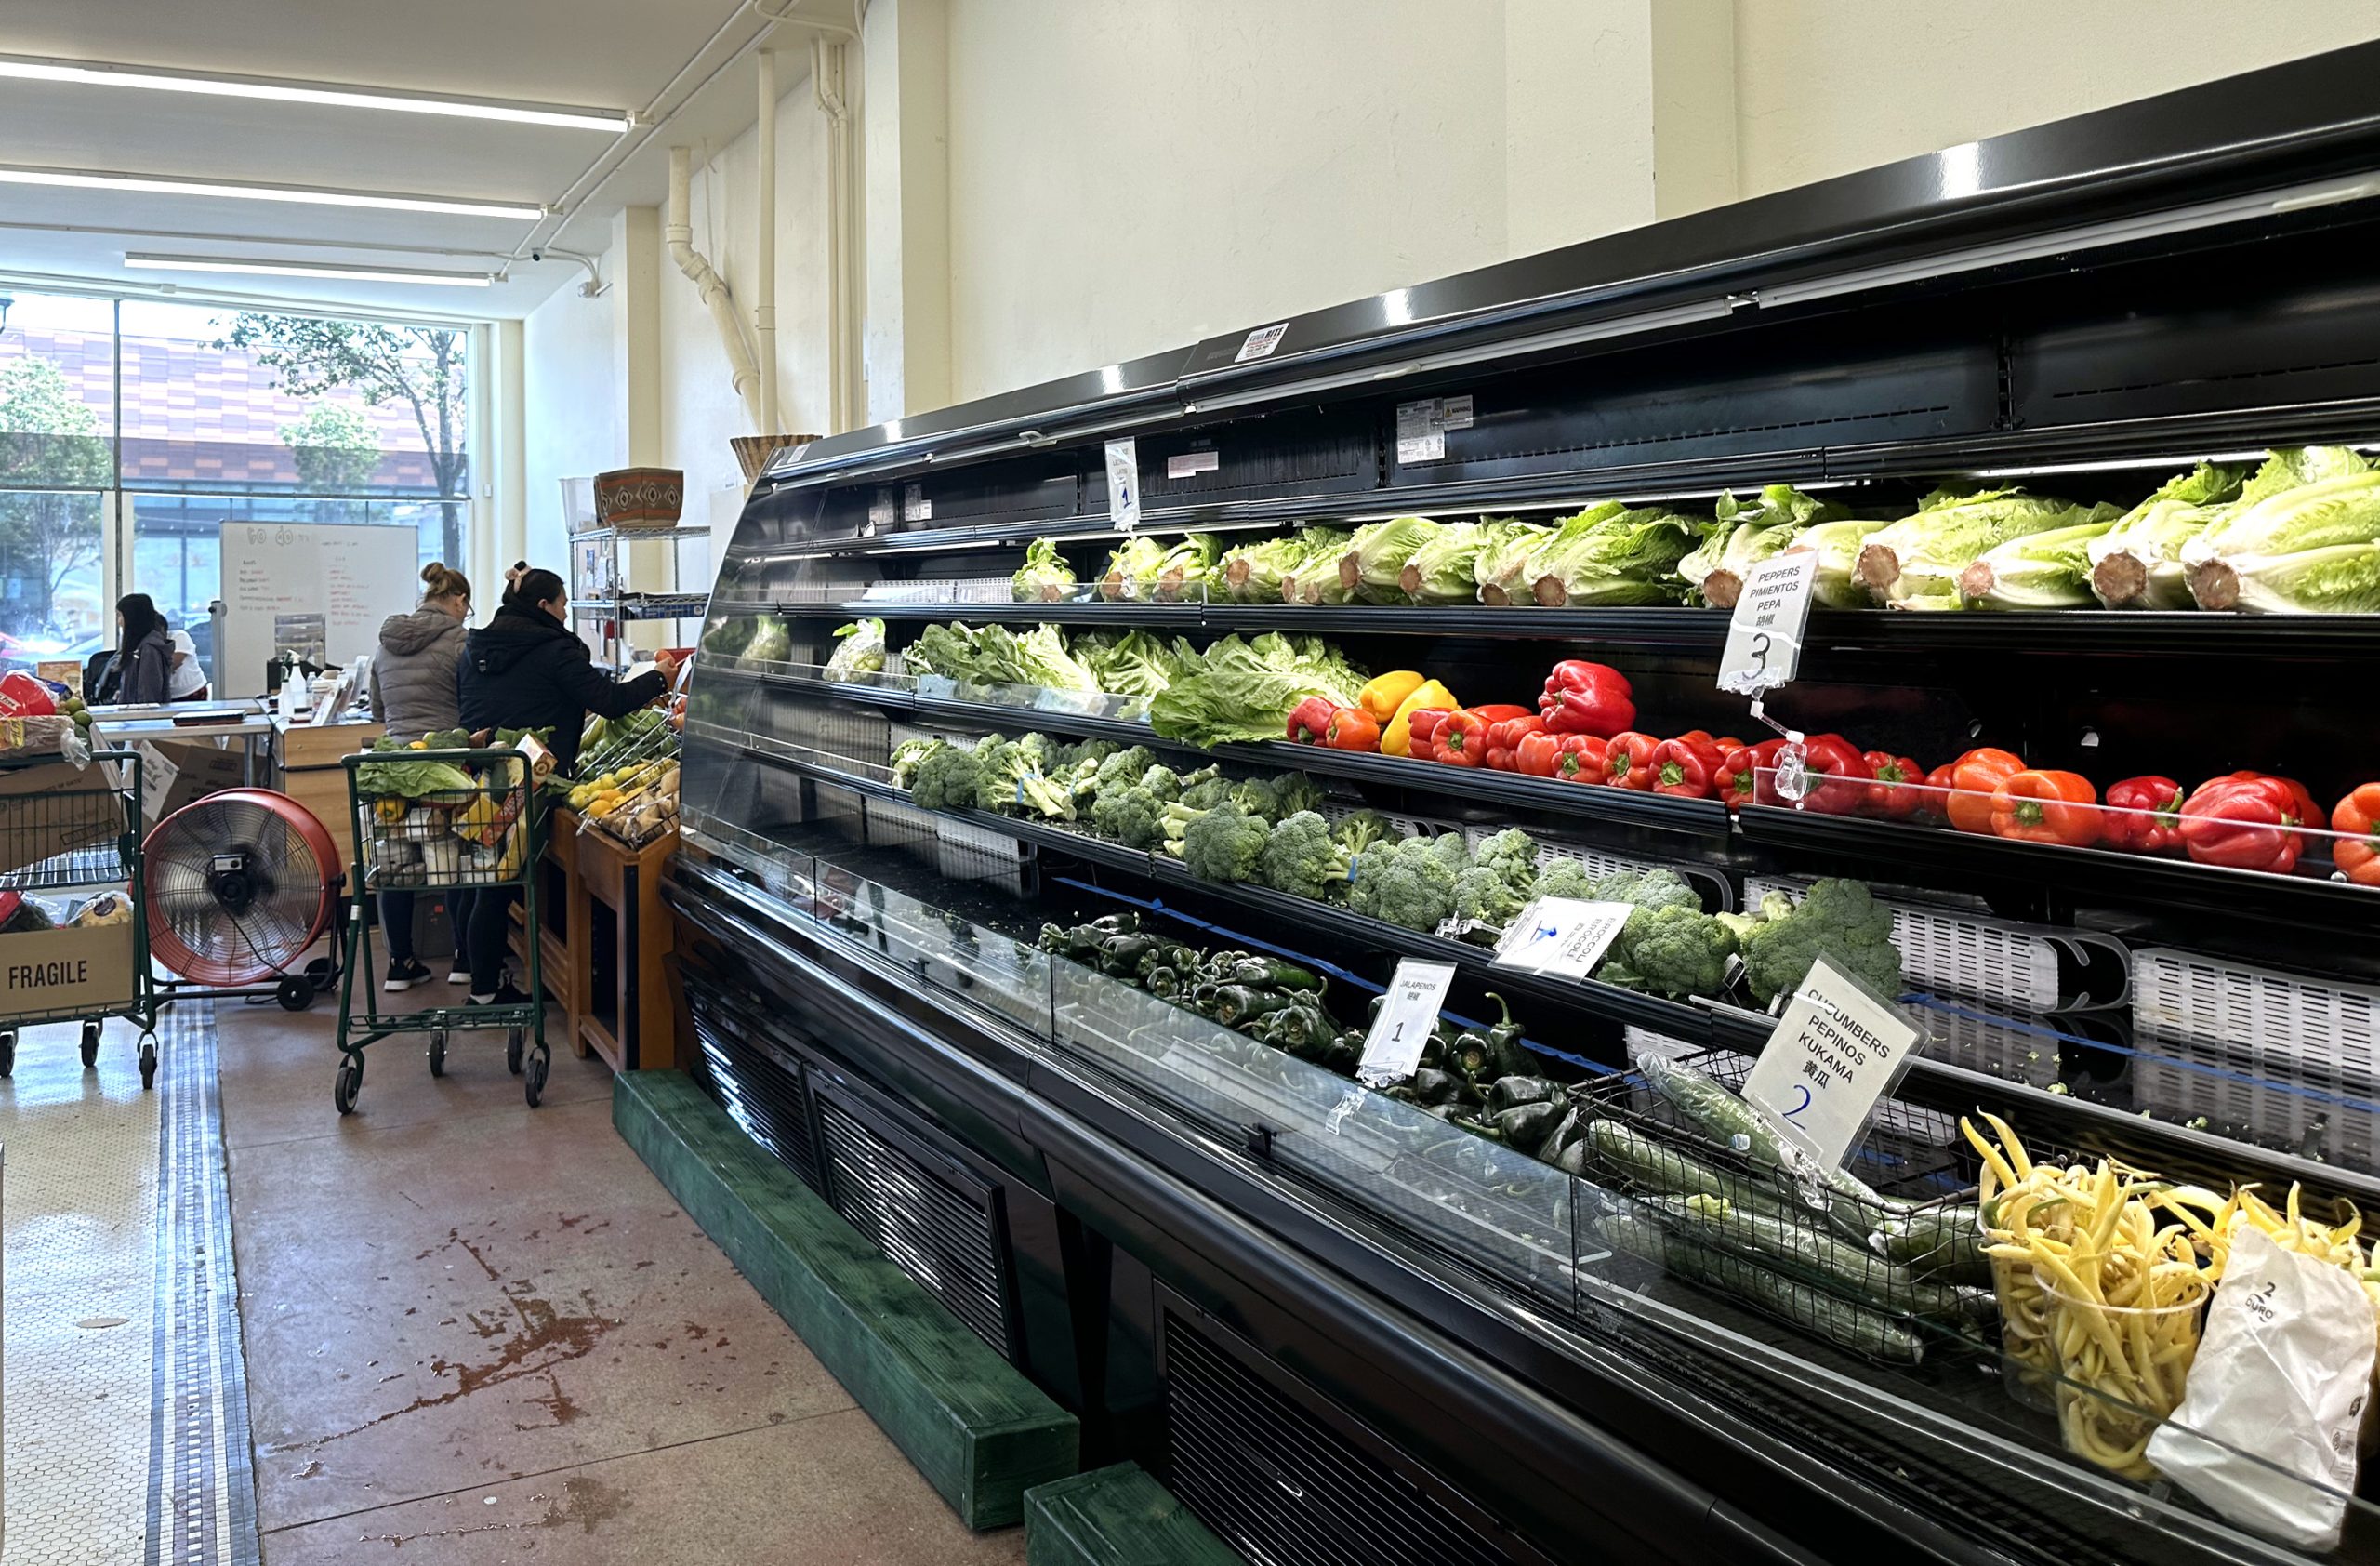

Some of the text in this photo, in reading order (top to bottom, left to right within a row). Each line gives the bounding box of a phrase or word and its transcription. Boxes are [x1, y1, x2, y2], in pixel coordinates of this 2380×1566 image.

[1758, 565, 1801, 583] PEPPERS
[1750, 581, 1800, 598] PIMIENTOS
[1757, 599, 1781, 611] PEPA
[1741, 632, 1771, 681] 3
[1575, 917, 1616, 962] BROCCOLI
[8, 960, 87, 989] FRAGILE
[1391, 1021, 1405, 1042] 1
[1808, 1015, 1866, 1066] PEPINOS
[1798, 1031, 1854, 1083] KUKAMA
[1782, 1084, 1812, 1131] 2
[2263, 1281, 2276, 1297] 2
[2245, 1297, 2274, 1320] DURO
